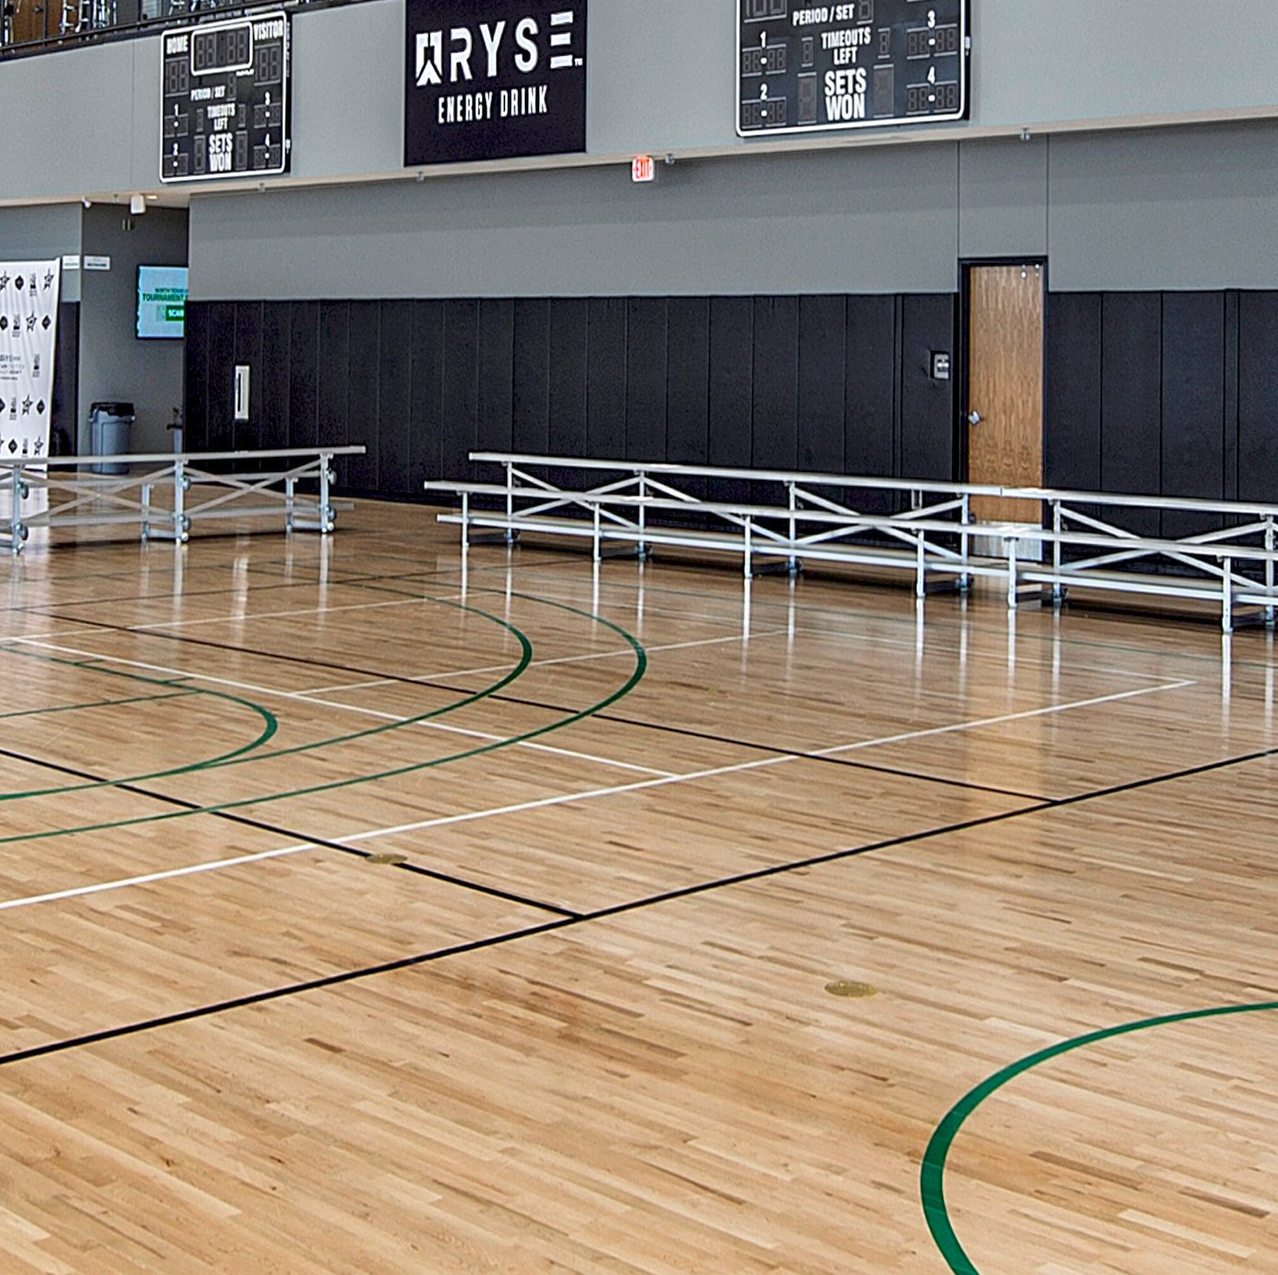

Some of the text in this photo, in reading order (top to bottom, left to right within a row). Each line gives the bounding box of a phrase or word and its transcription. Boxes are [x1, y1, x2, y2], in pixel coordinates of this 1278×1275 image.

[793, 7, 828, 26] PERIOD
[836, 4, 855, 21] SET
[927, 10, 935, 28] 3
[166, 20, 283, 54] HOME VISITOR
[760, 32, 766, 47] 1
[822, 27, 871, 49] TIMEOUTS
[450, 11, 573, 82] RYSE
[834, 47, 858, 65] LEFT
[825, 68, 867, 96] SETS
[927, 67, 935, 84] 4
[190, 87, 211, 101] PERIOD
[214, 86, 226, 98] SET
[265, 92, 270, 105] 3
[760, 84, 767, 100] 2
[174, 104, 179, 117] 1
[207, 103, 236, 119] TIMEOUTS
[438, 85, 547, 124] ENERGY DRINK
[826, 93, 866, 121] WON
[213, 118, 228, 131] LEFT
[209, 133, 233, 154] SETS
[265, 133, 270, 146] 4
[173, 143, 179, 156] 2
[209, 152, 232, 172] WON
